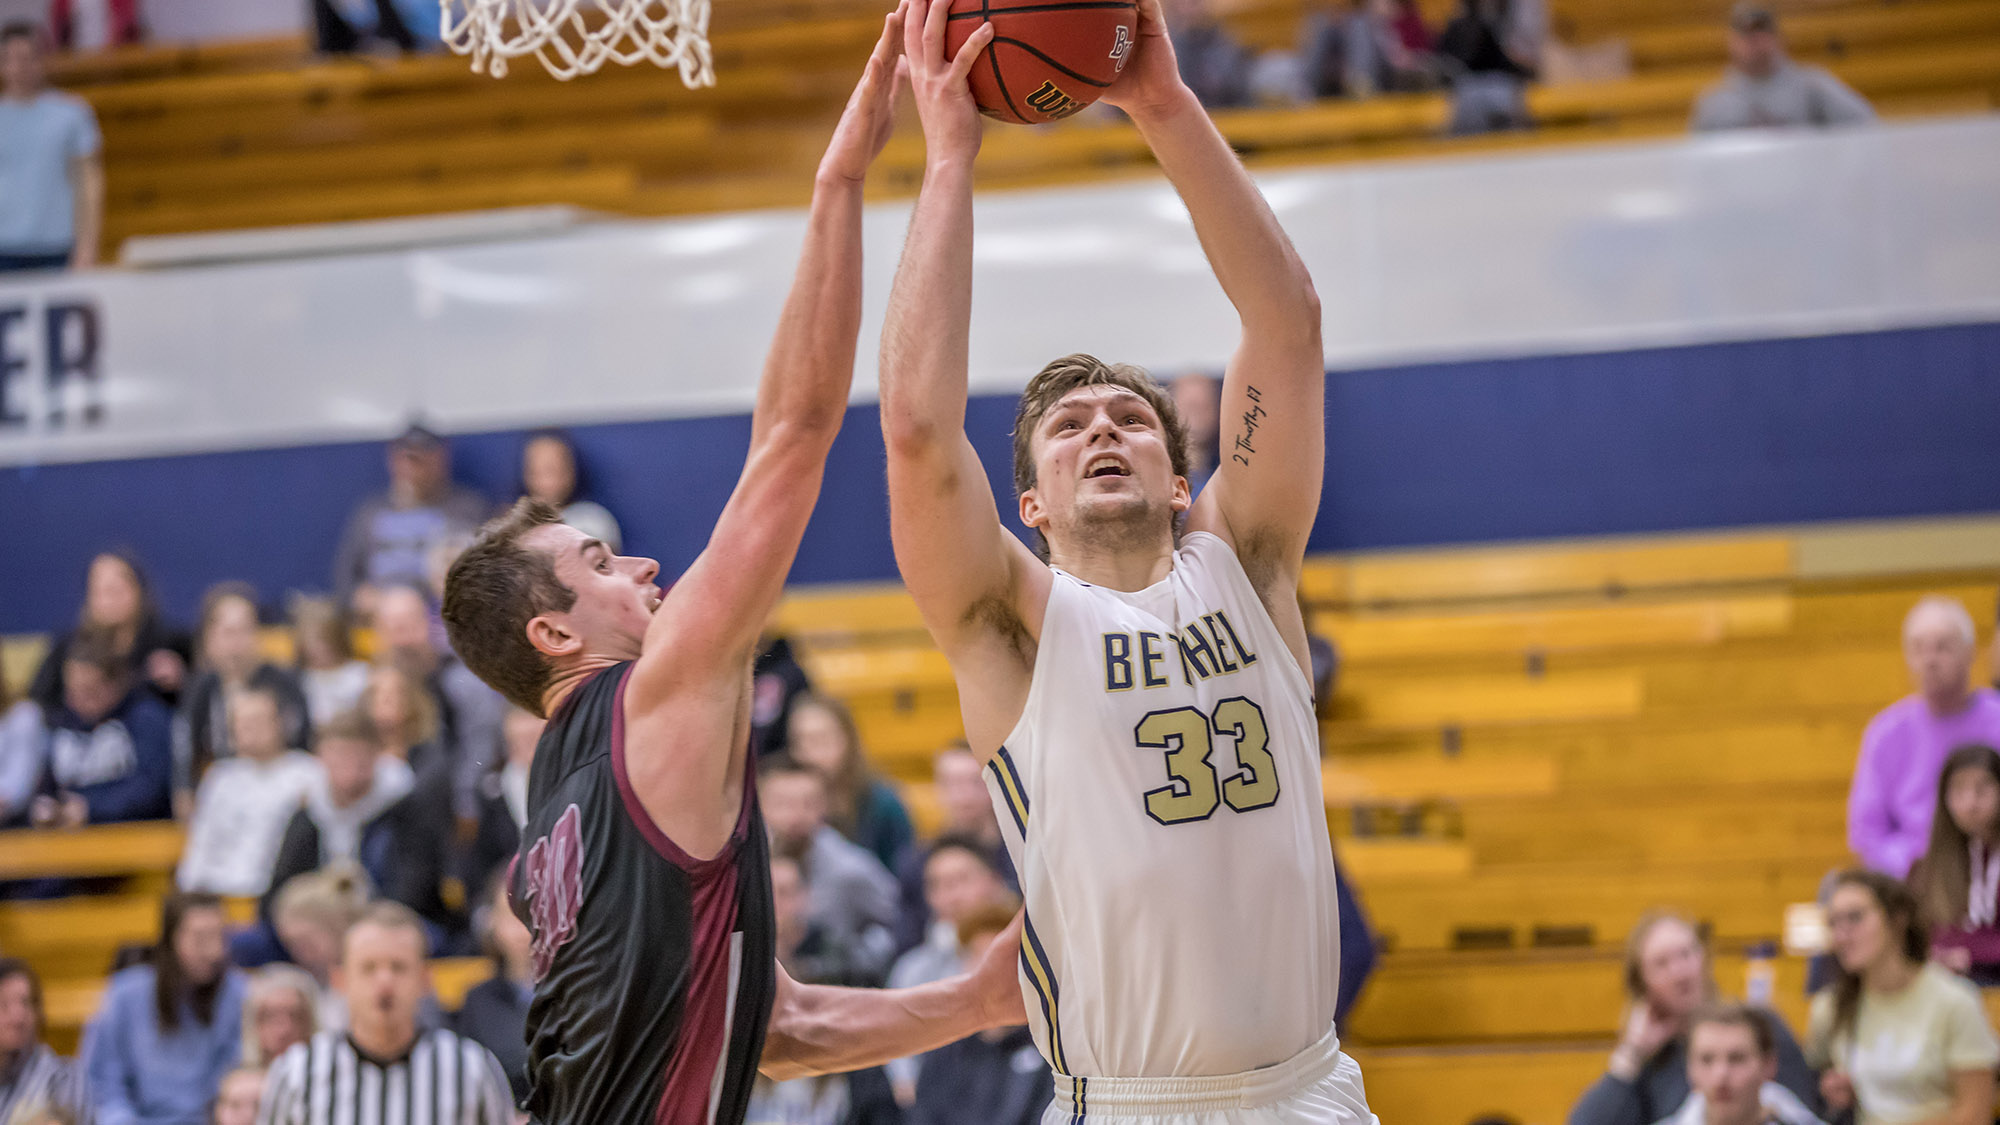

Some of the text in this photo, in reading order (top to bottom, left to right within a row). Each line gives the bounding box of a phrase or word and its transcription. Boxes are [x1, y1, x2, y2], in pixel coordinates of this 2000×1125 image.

[1232, 453, 1249, 467] 2
[1235, 405, 1267, 453] Timothy
[1102, 608, 1257, 693] BETHEL
[1134, 695, 1280, 826] 33
